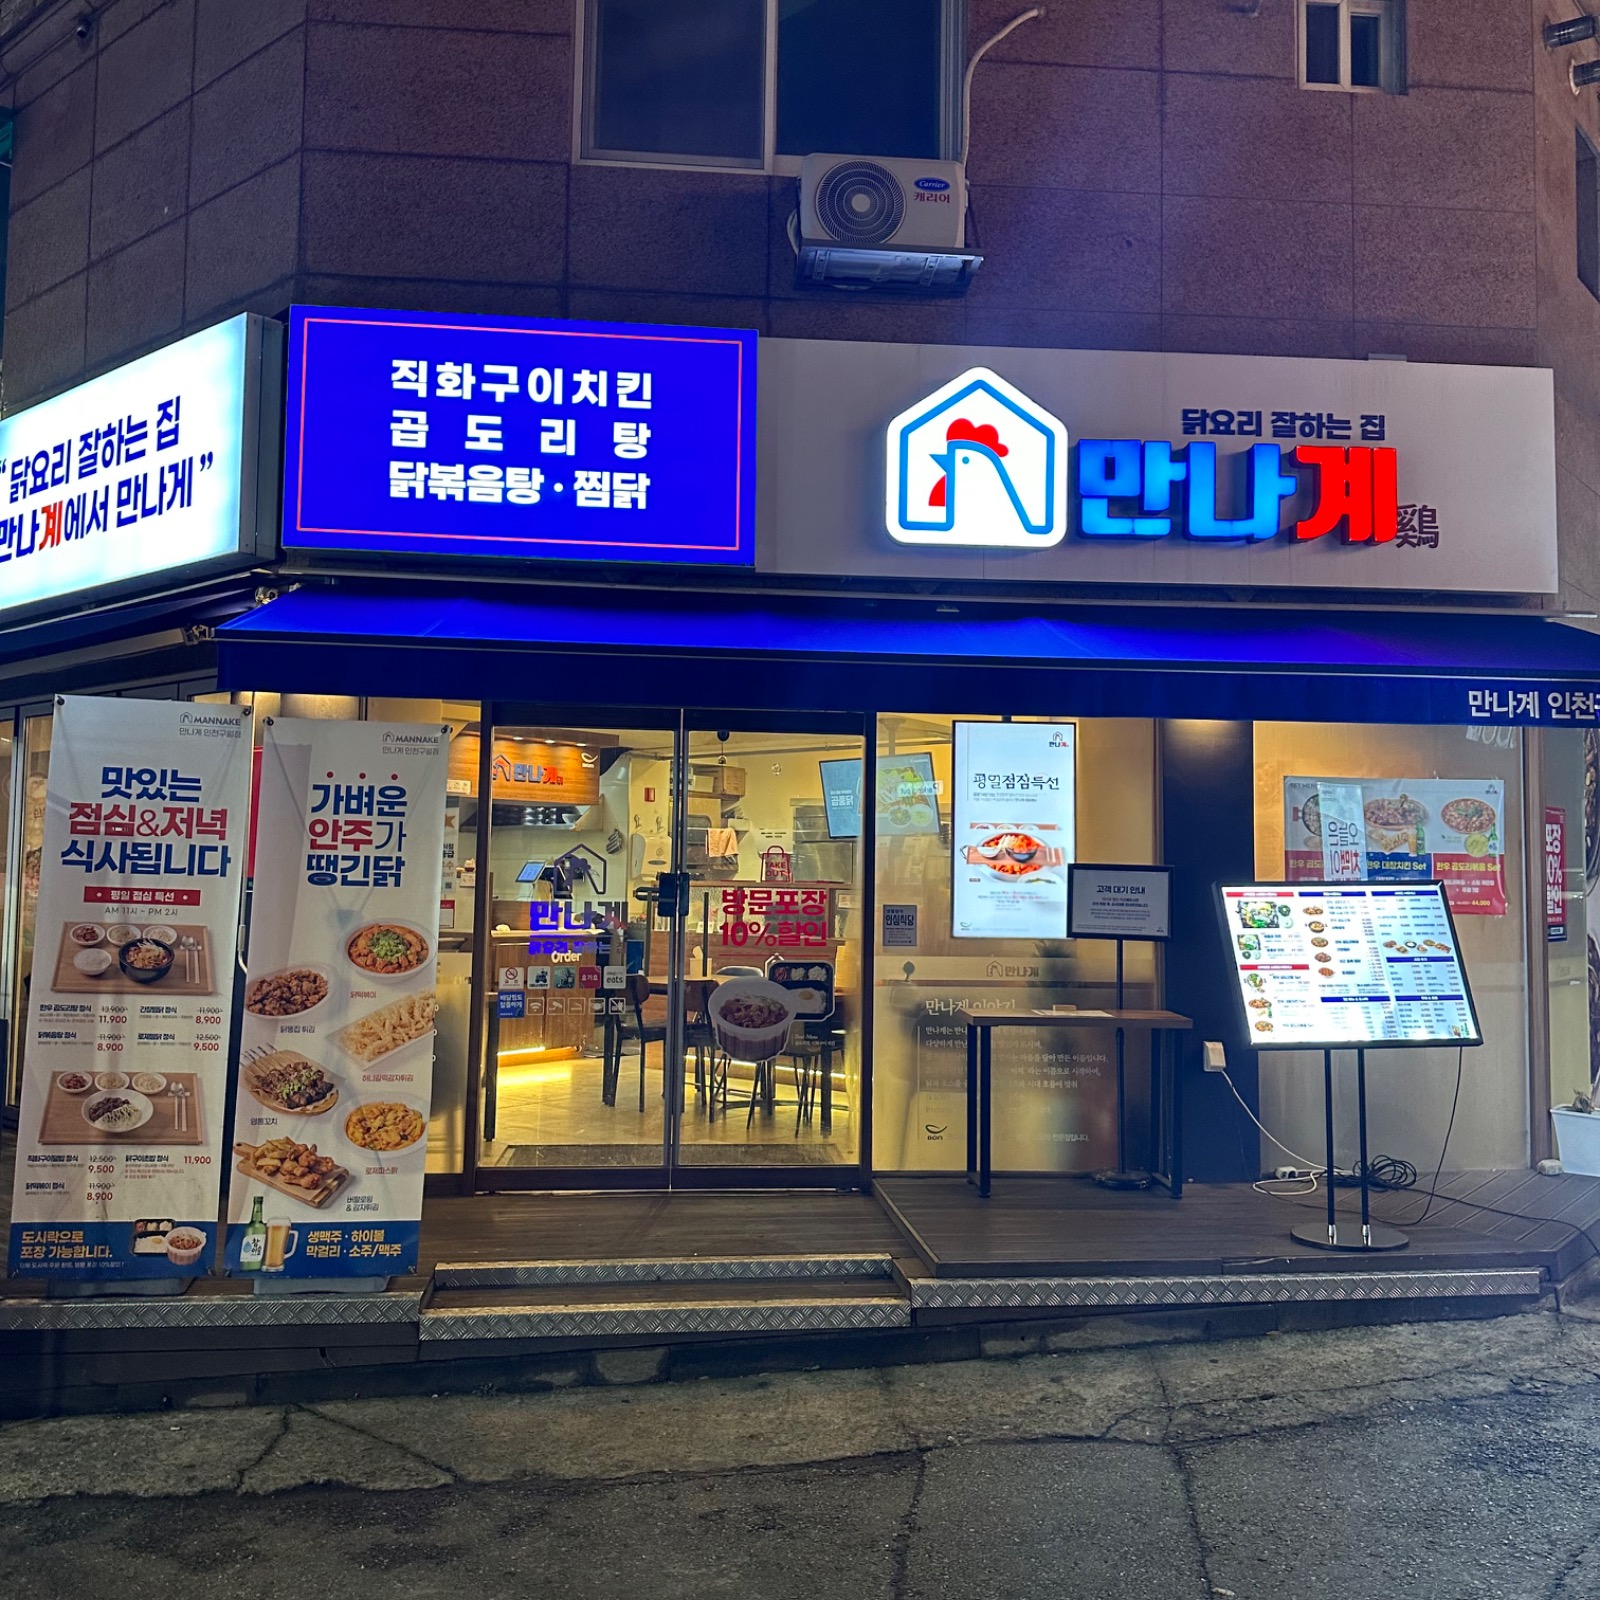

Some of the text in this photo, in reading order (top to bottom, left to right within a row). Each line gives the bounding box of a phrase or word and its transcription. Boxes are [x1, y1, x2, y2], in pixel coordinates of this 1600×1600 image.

[918, 180, 946, 189] Carrier
[914, 191, 951, 204] 캐리어
[390, 358, 653, 411] 직화구이치킨
[1181, 408, 1386, 442] 닭요리 잘하는 집
[78, 415, 148, 479] 잘하는
[156, 395, 181, 452] 집
[389, 461, 651, 511] 닭볶음탕 찜닭
[1078, 438, 1398, 546] 만나계
[0, 484, 110, 563] 만나계에서
[1468, 689, 1540, 719] 만나계
[194, 716, 241, 727] MANNAKE
[395, 735, 439, 744] MANNAKE
[101, 766, 202, 802] 맛있는
[310, 783, 408, 818] 가벼운
[69, 802, 228, 841] 점심&저녁
[308, 818, 407, 852] 안주가
[60, 839, 232, 877] 식사됩니다
[765, 861, 786, 869] TAKE
[306, 853, 406, 887] 땡긴닭
[1412, 861, 1427, 870] Set
[110, 889, 131, 902] 평일
[132, 890, 153, 902] 점심
[1096, 885, 1146, 895] 고객 대기 안내
[721, 889, 827, 917] 방문포장
[104, 907, 119, 915] AM
[121, 907, 138, 916] 11시
[148, 908, 162, 916] PM
[164, 908, 178, 917] 2시
[885, 914, 914, 926] 안심식당
[719, 921, 828, 947] 10%할인
[551, 950, 582, 964] Order
[98, 1015, 127, 1024] 11,900
[195, 1015, 221, 1025] 8,900
[97, 1043, 124, 1052] 8,900
[193, 1042, 219, 1052] 9,500
[89, 1155, 115, 1163] 12,500
[184, 1155, 212, 1165] 11,900
[88, 1164, 115, 1174] 9,500
[86, 1192, 113, 1201] 8,900
[21, 1230, 84, 1244] 도시락으로
[307, 1229, 385, 1244] 생맥주 하이볼
[20, 1244, 113, 1259] 포장 가능합니다.
[306, 1243, 402, 1258] 막걸리 소주/맥주
